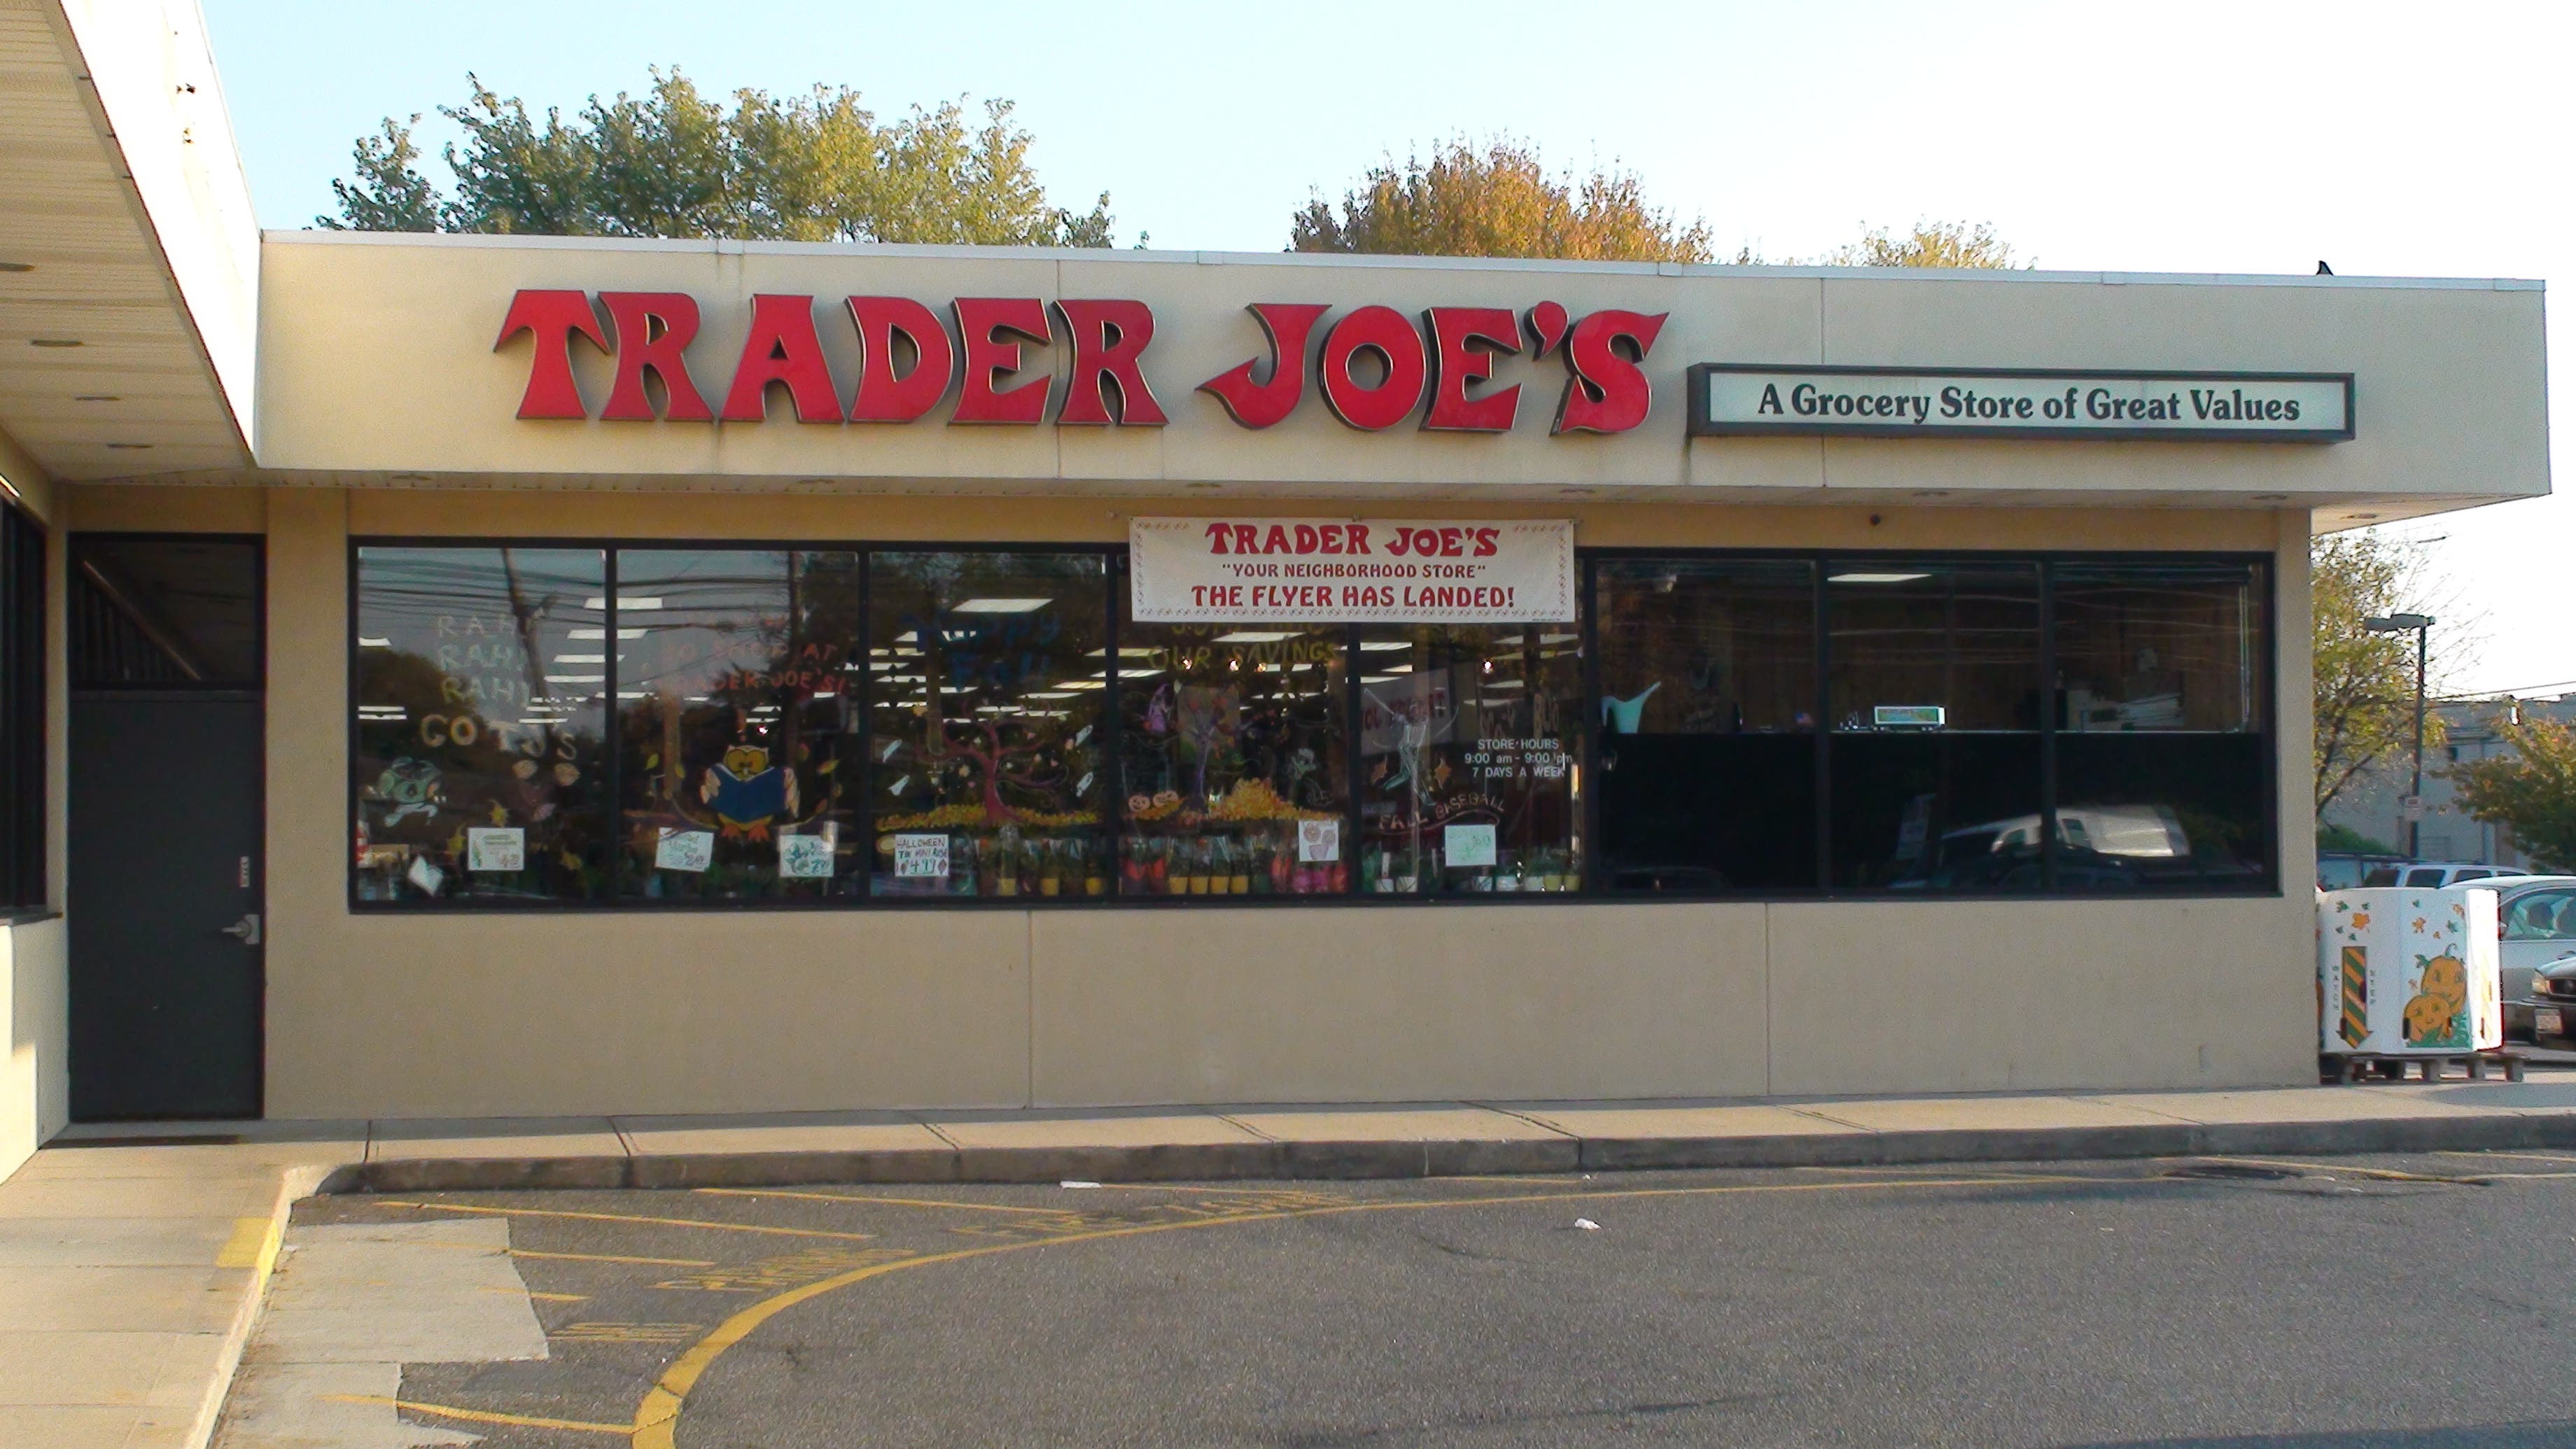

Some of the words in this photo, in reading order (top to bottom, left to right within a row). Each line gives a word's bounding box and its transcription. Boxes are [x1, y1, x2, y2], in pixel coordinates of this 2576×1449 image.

[492, 289, 1170, 427] TRADER
[1195, 300, 1670, 437] JOE'S
[1758, 383, 1784, 415] A
[1791, 384, 1931, 424] Grocery
[1940, 386, 2033, 419] Store
[2043, 387, 2078, 420] of
[2086, 388, 2181, 421] Great
[2190, 388, 2301, 421] Values
[1205, 522, 1372, 555] TRADER
[1384, 527, 1501, 557] JOE'S
[1284, 564, 1417, 578] NEIGHBORHOOD
[1191, 585, 1243, 607] THE
[1252, 585, 1333, 607] FLYER
[1343, 585, 1395, 607] HAS
[1404, 586, 1514, 608] LANDED!
[420, 713, 479, 748] GO
[1478, 738, 1515, 750] STORE
[1520, 738, 1560, 750] HOURS
[1464, 752, 1490, 764] 9:00
[1496, 755, 1513, 764] am
[1525, 752, 1550, 764] 9:00
[1472, 766, 1480, 778] 7
[1485, 766, 1513, 778] DAYS
[1518, 767, 1527, 778] A
[1533, 766, 1566, 778] WEEK
